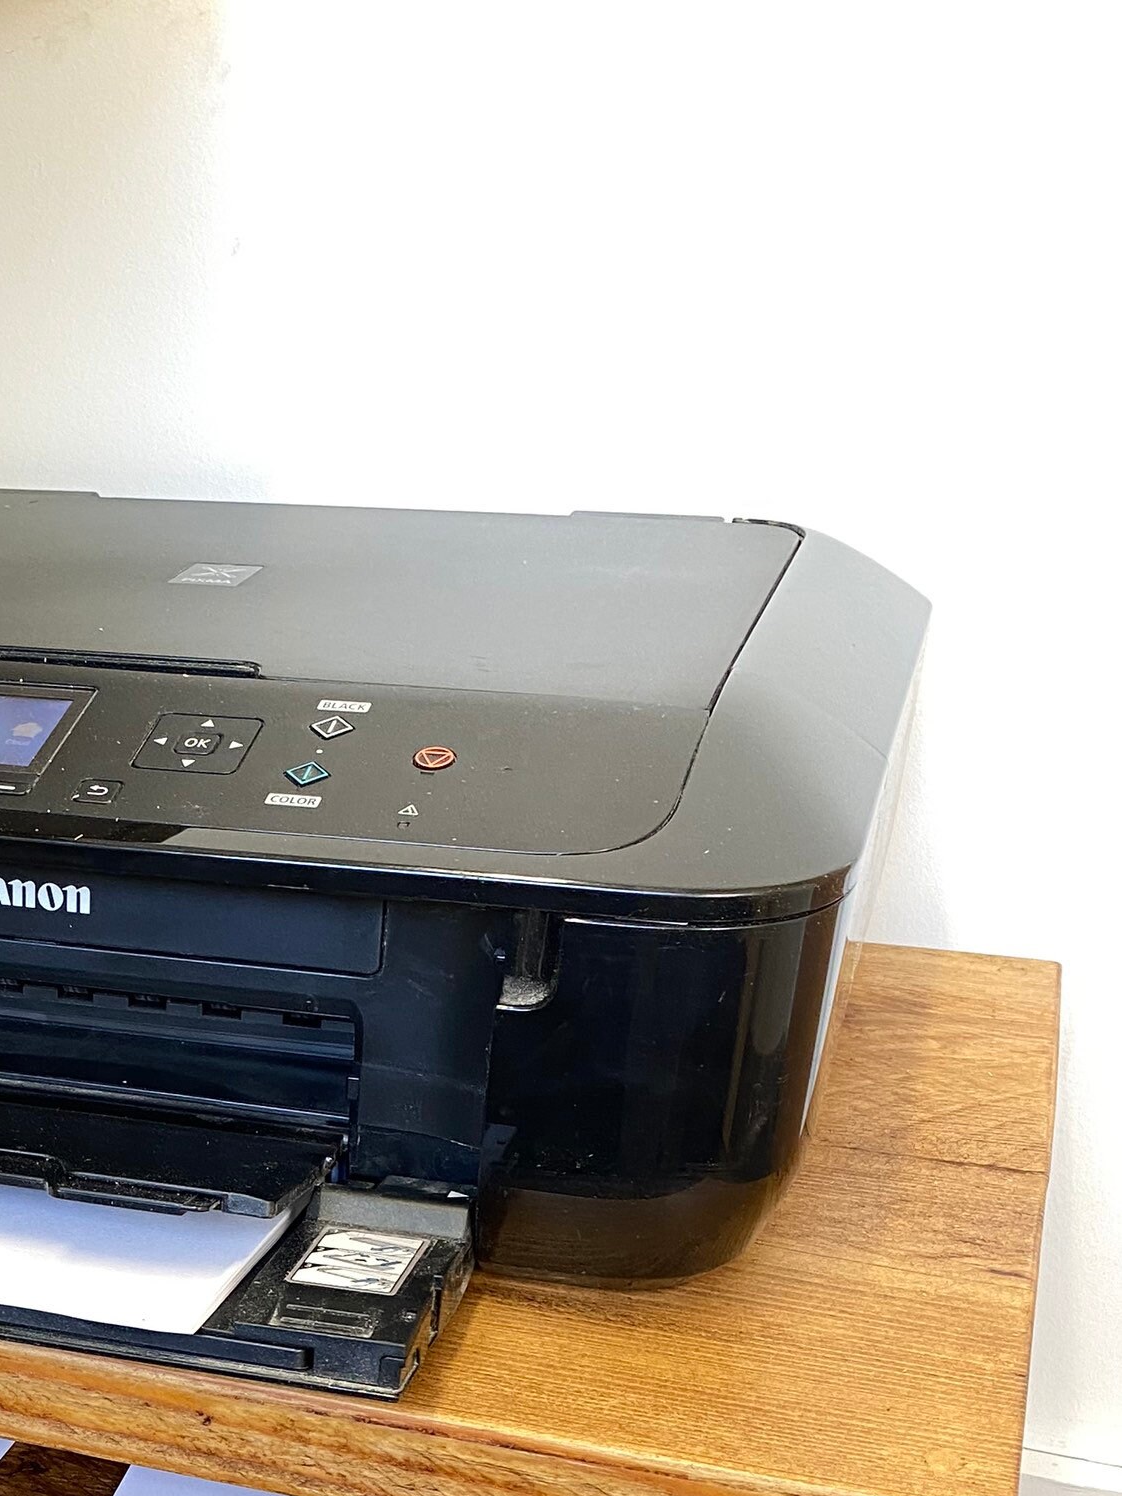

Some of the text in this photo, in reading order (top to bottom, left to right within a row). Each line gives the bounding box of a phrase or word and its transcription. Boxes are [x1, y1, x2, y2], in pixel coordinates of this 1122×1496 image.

[322, 701, 367, 711] BLACK
[184, 737, 211, 749] OK
[270, 794, 318, 806] COLOR
